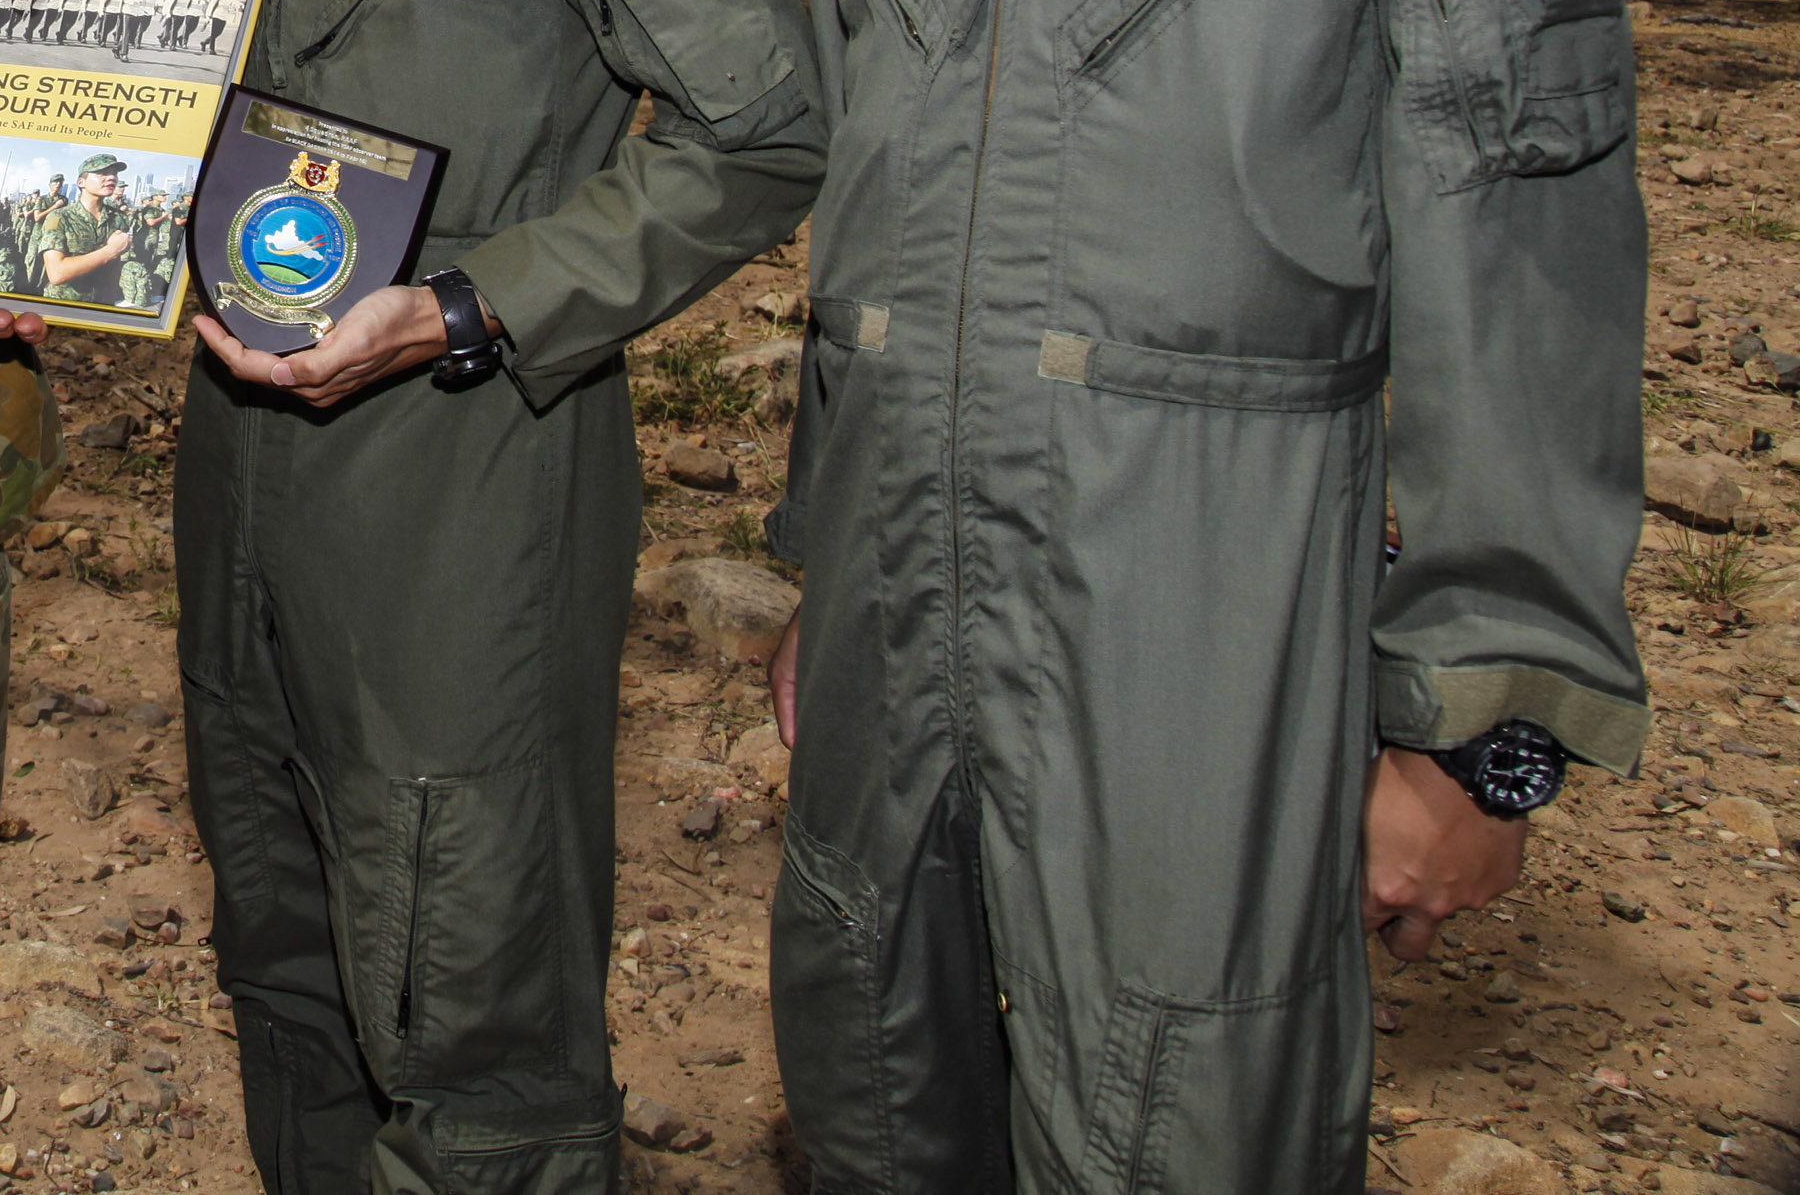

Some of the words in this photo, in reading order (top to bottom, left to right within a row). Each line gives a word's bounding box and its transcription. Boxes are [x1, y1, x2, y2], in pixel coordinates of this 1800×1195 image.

[37, 77, 198, 109] STRENGTH
[56, 101, 170, 129] NATION
[11, 120, 34, 131] SAF
[36, 122, 58, 133] and
[59, 124, 74, 135] Its
[77, 126, 113, 139] People
